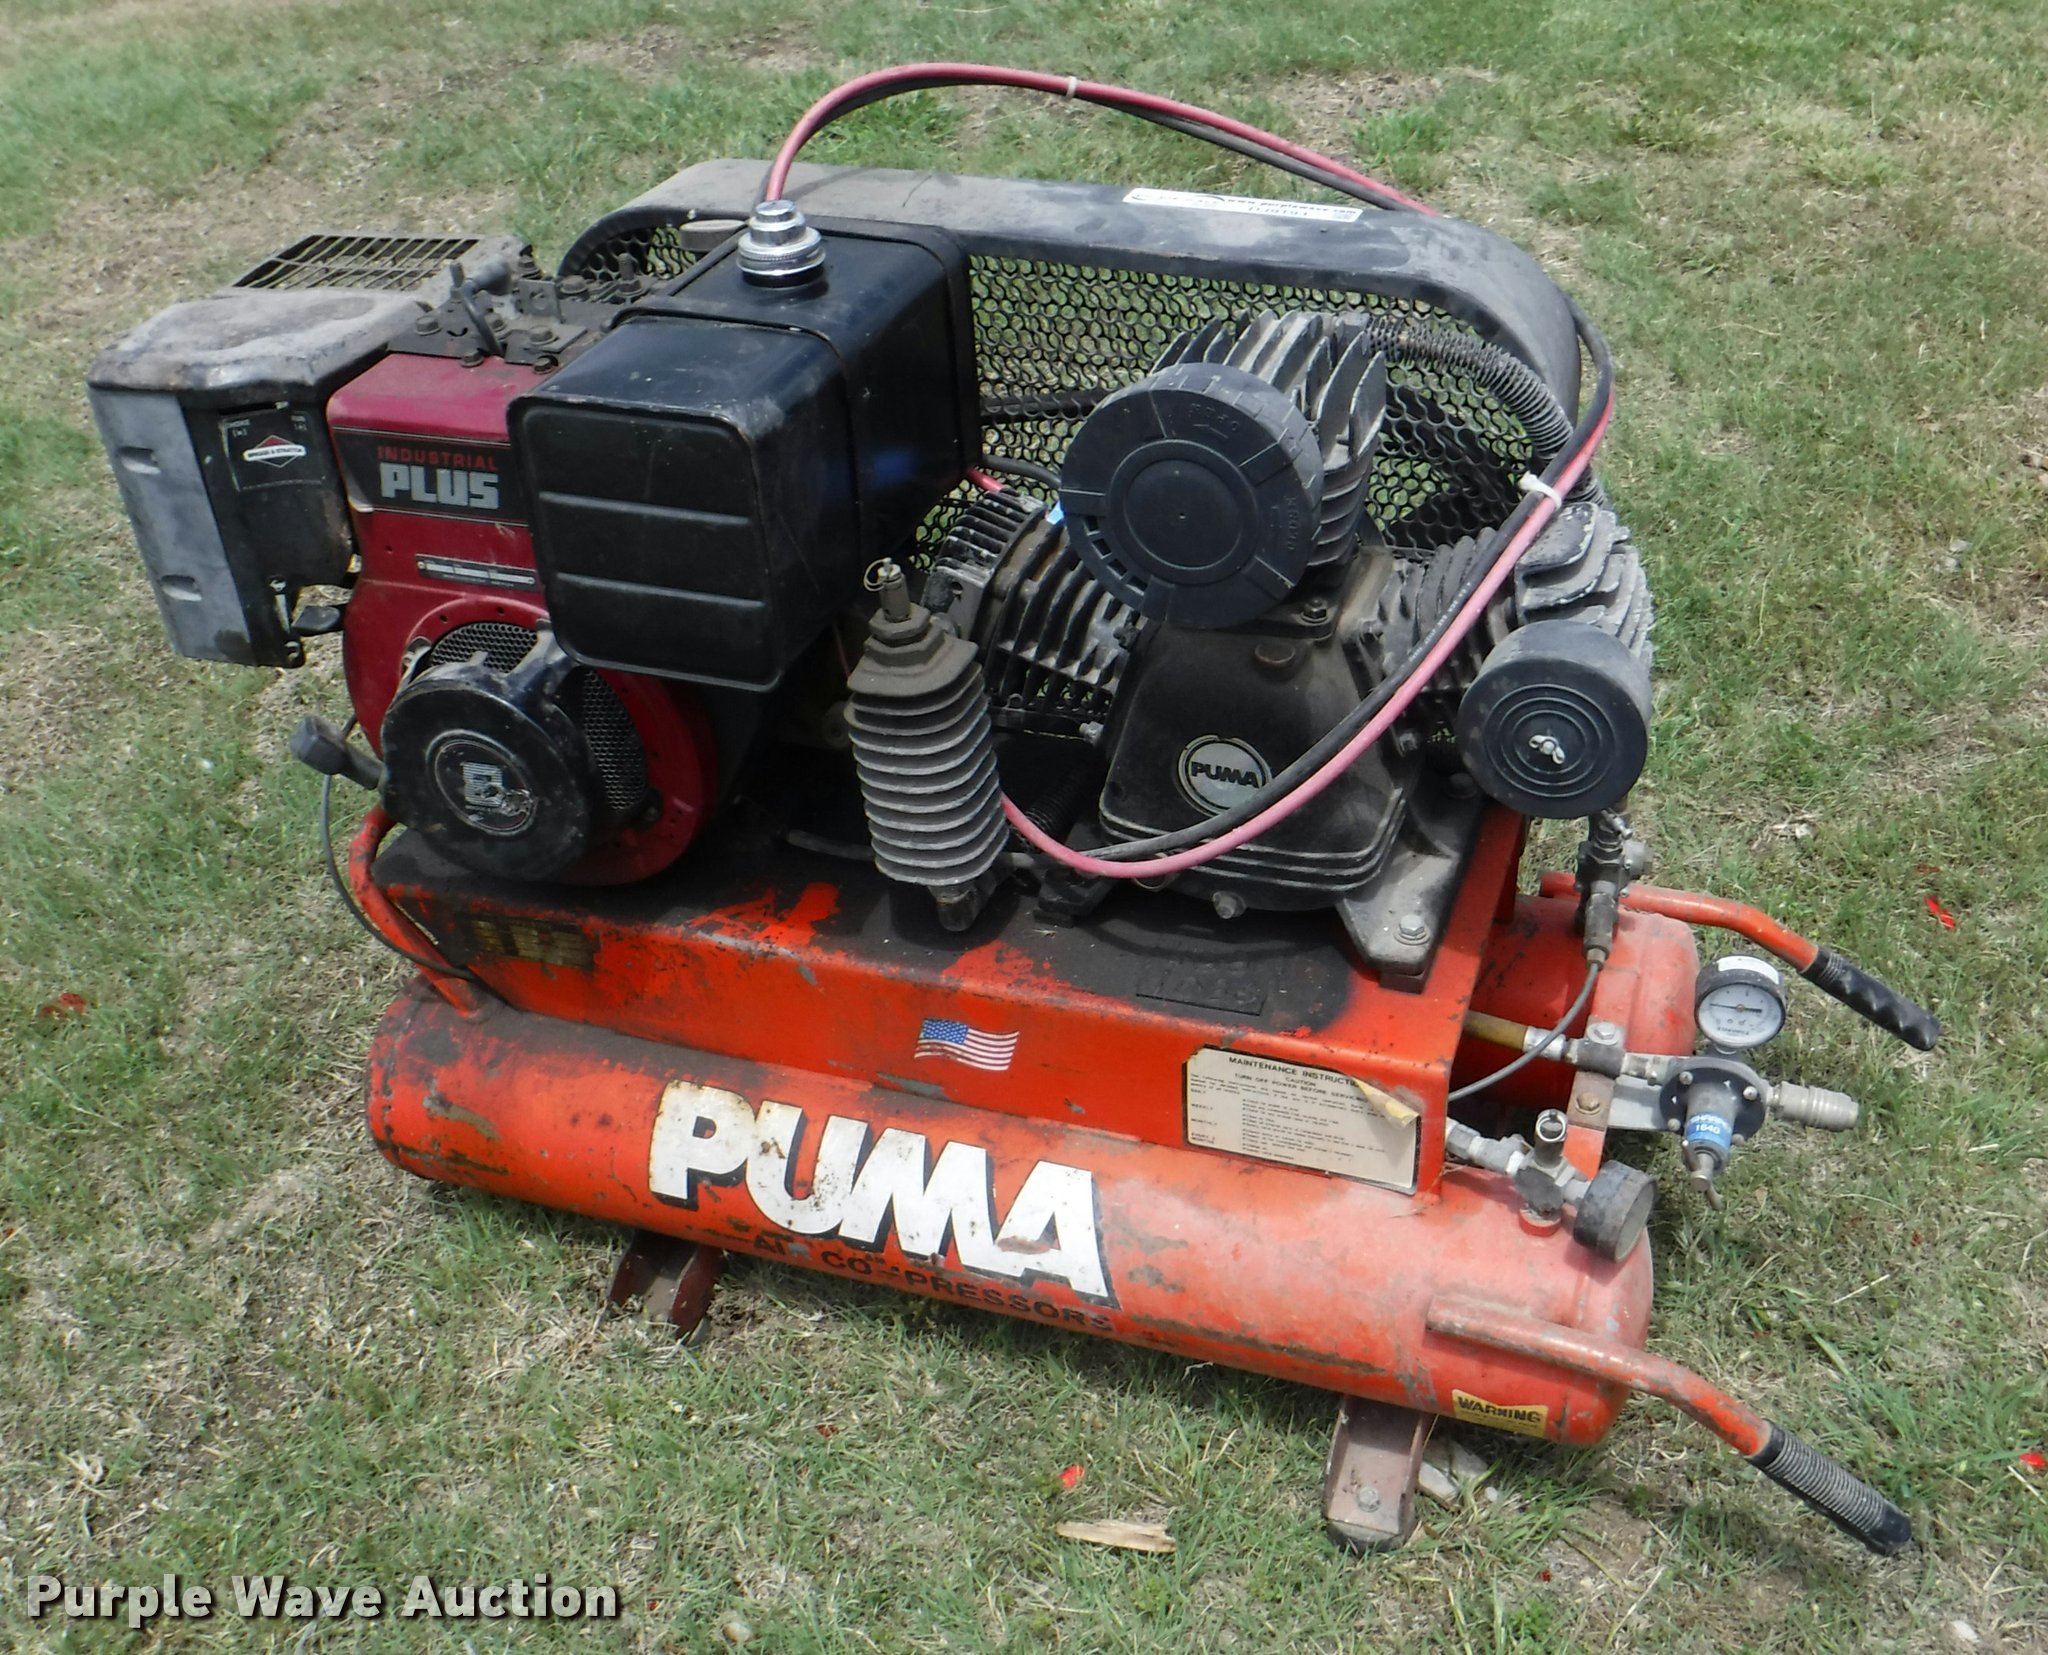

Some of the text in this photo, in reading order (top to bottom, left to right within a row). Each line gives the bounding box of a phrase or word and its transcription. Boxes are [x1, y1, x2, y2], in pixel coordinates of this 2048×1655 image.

[377, 446, 498, 472] INDUSTRIAL
[380, 461, 500, 510] PLUS
[1190, 760, 1260, 789] PUMA
[1228, 1056, 1298, 1076] MAINTENANCE
[1284, 1075, 1317, 1088] CAUTION
[648, 1079, 1113, 1302] PUMA
[820, 1250, 1113, 1333] COPRESSORS
[1457, 1396, 1542, 1423] WARNING
